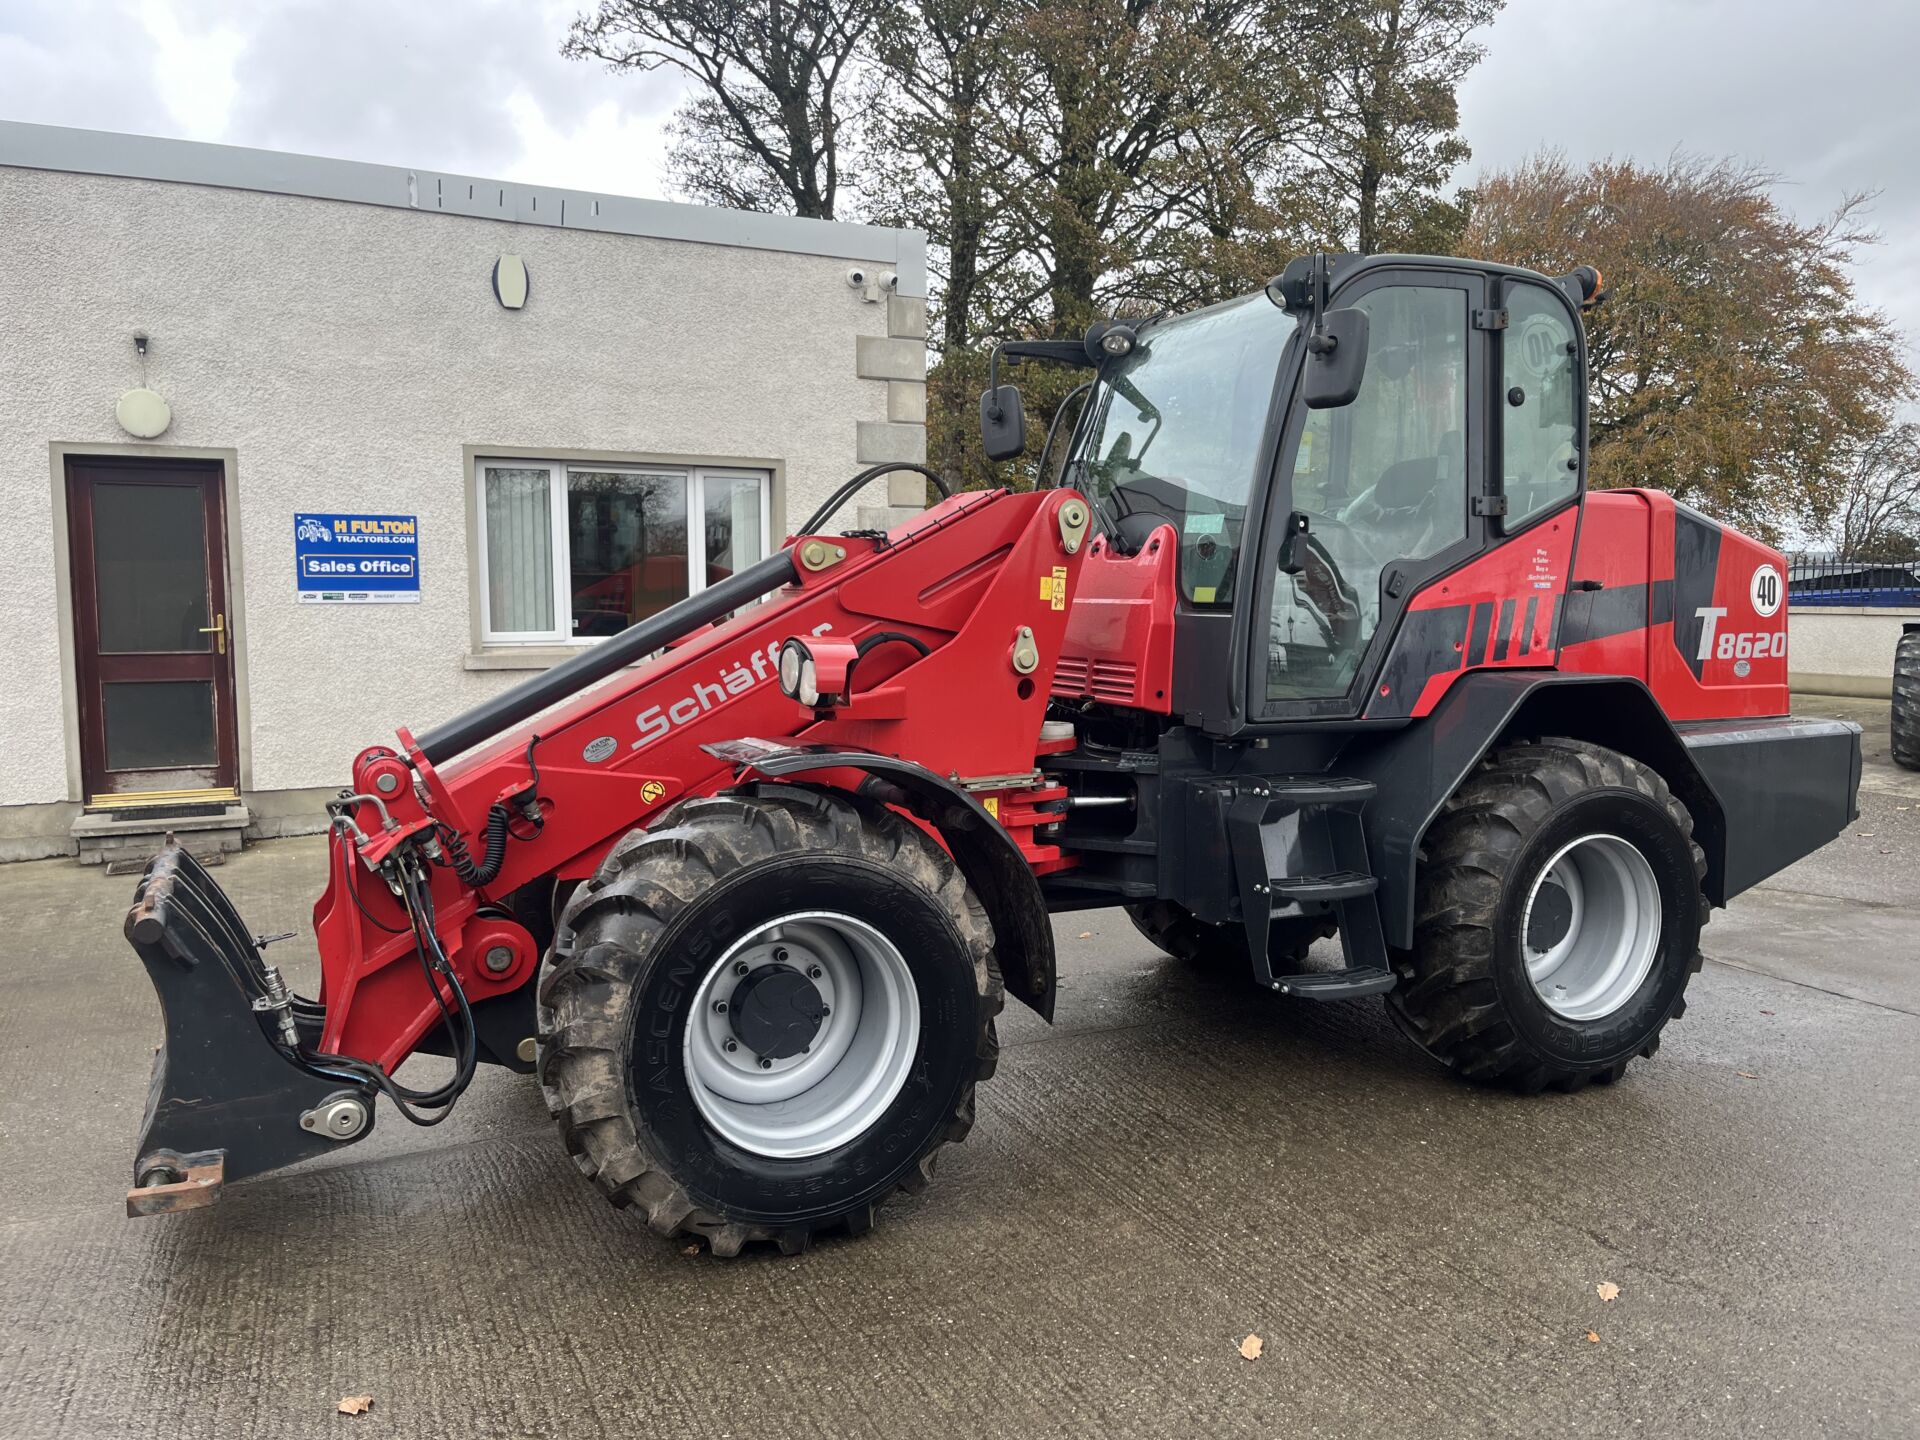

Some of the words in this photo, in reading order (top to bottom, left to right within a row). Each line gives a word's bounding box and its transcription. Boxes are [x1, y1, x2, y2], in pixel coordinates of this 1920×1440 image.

[334, 520, 347, 533] H
[351, 521, 415, 534] FULTON
[336, 535, 415, 544] TRACTORS.COM
[308, 560, 356, 572] Sales
[360, 561, 411, 573] Office
[1757, 575, 1777, 606] 40
[631, 622, 833, 750] Schäffr
[648, 908, 734, 1094] ASCENSO
